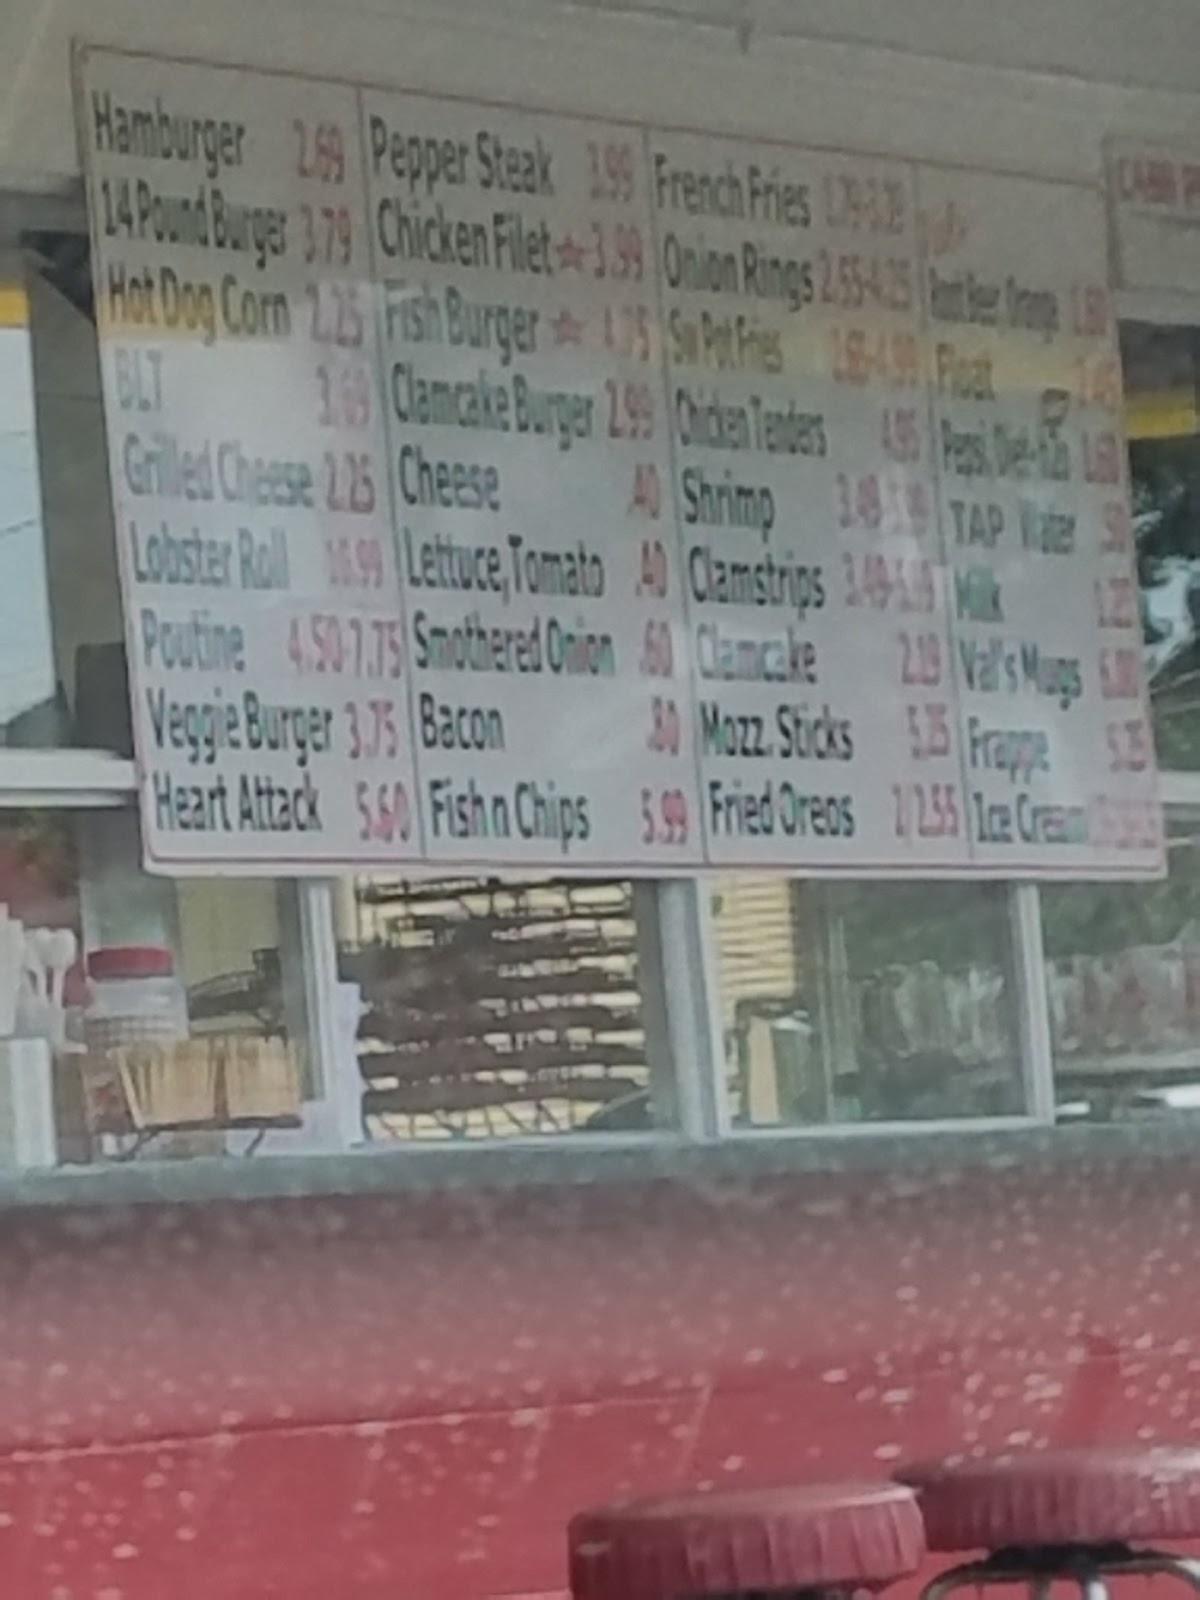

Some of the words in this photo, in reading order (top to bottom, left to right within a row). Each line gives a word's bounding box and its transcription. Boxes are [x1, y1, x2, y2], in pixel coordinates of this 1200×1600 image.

[92, 89, 245, 179] Hamburger
[370, 113, 467, 195] Pepper
[476, 130, 554, 196] Steak
[137, 178, 208, 247] Pound
[211, 187, 287, 270] Burger
[655, 153, 744, 218] French
[748, 164, 810, 228] Fries
[378, 197, 489, 266] Chicken
[108, 262, 154, 323] Hot
[160, 266, 217, 347] Dog
[222, 272, 291, 335] Corn
[664, 231, 739, 294] Onion
[742, 241, 813, 313] Rings
[384, 278, 442, 343] Fish
[446, 286, 539, 367] Burger
[393, 363, 509, 432] Clamcake
[513, 373, 593, 450] Burger
[676, 387, 746, 450] Chicken
[750, 394, 827, 457] Tenders
[124, 431, 213, 500] Grilled
[218, 440, 314, 507] Cheese
[400, 445, 499, 511] Cheese
[682, 466, 775, 543] Shrimp
[129, 520, 232, 587] Lobster
[238, 527, 290, 589] Roll
[950, 501, 1004, 549] TAP
[689, 545, 825, 621] Clamstrips
[141, 608, 245, 672] Poutine
[413, 609, 542, 673] Smothered
[547, 616, 616, 675] Onion
[697, 623, 817, 684] Clamcake
[146, 686, 241, 765] Veggie
[243, 690, 332, 767] Burger
[419, 692, 505, 750] Bacon
[776, 703, 854, 760] Sticks
[153, 770, 231, 831] Heart
[239, 770, 322, 831] Attack
[515, 780, 590, 853] Chips
[709, 779, 774, 837] Fried
[780, 781, 855, 837] Oreos
[973, 792, 1013, 843] Ice
